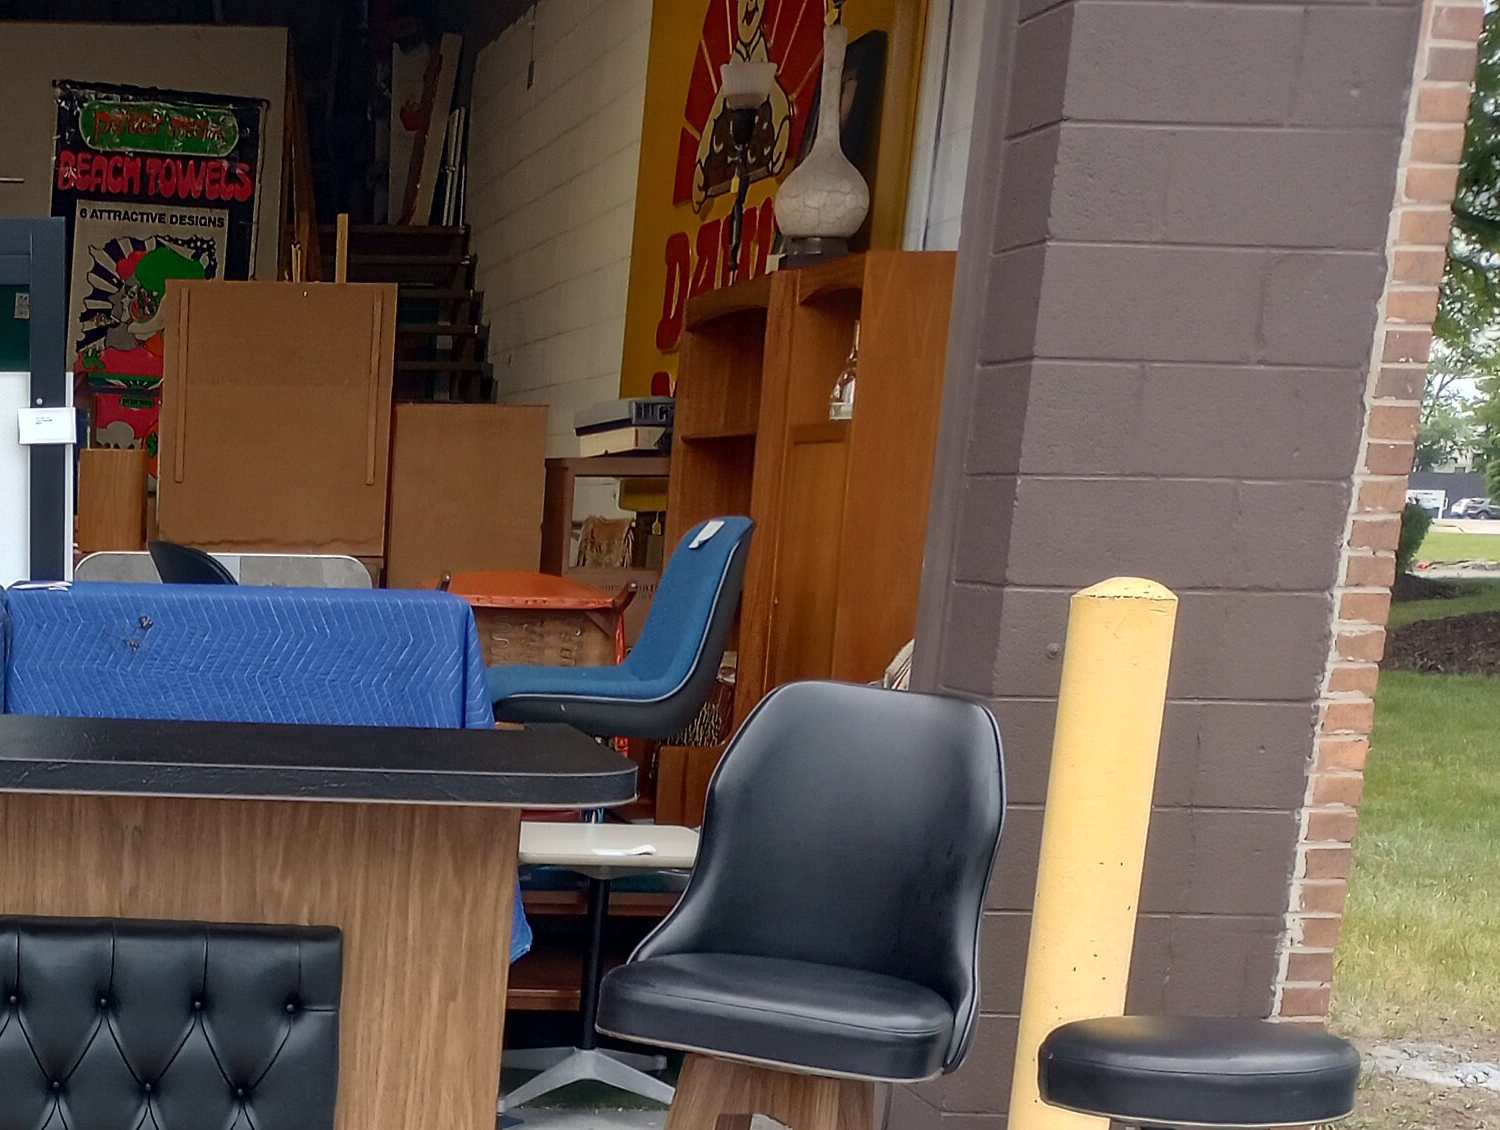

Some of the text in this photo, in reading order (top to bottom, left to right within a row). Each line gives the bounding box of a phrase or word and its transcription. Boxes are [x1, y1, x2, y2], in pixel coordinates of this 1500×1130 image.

[57, 150, 254, 203] BEACH TOWELS
[79, 208, 225, 228] 6 ATTRACTIVE DESIGNS
